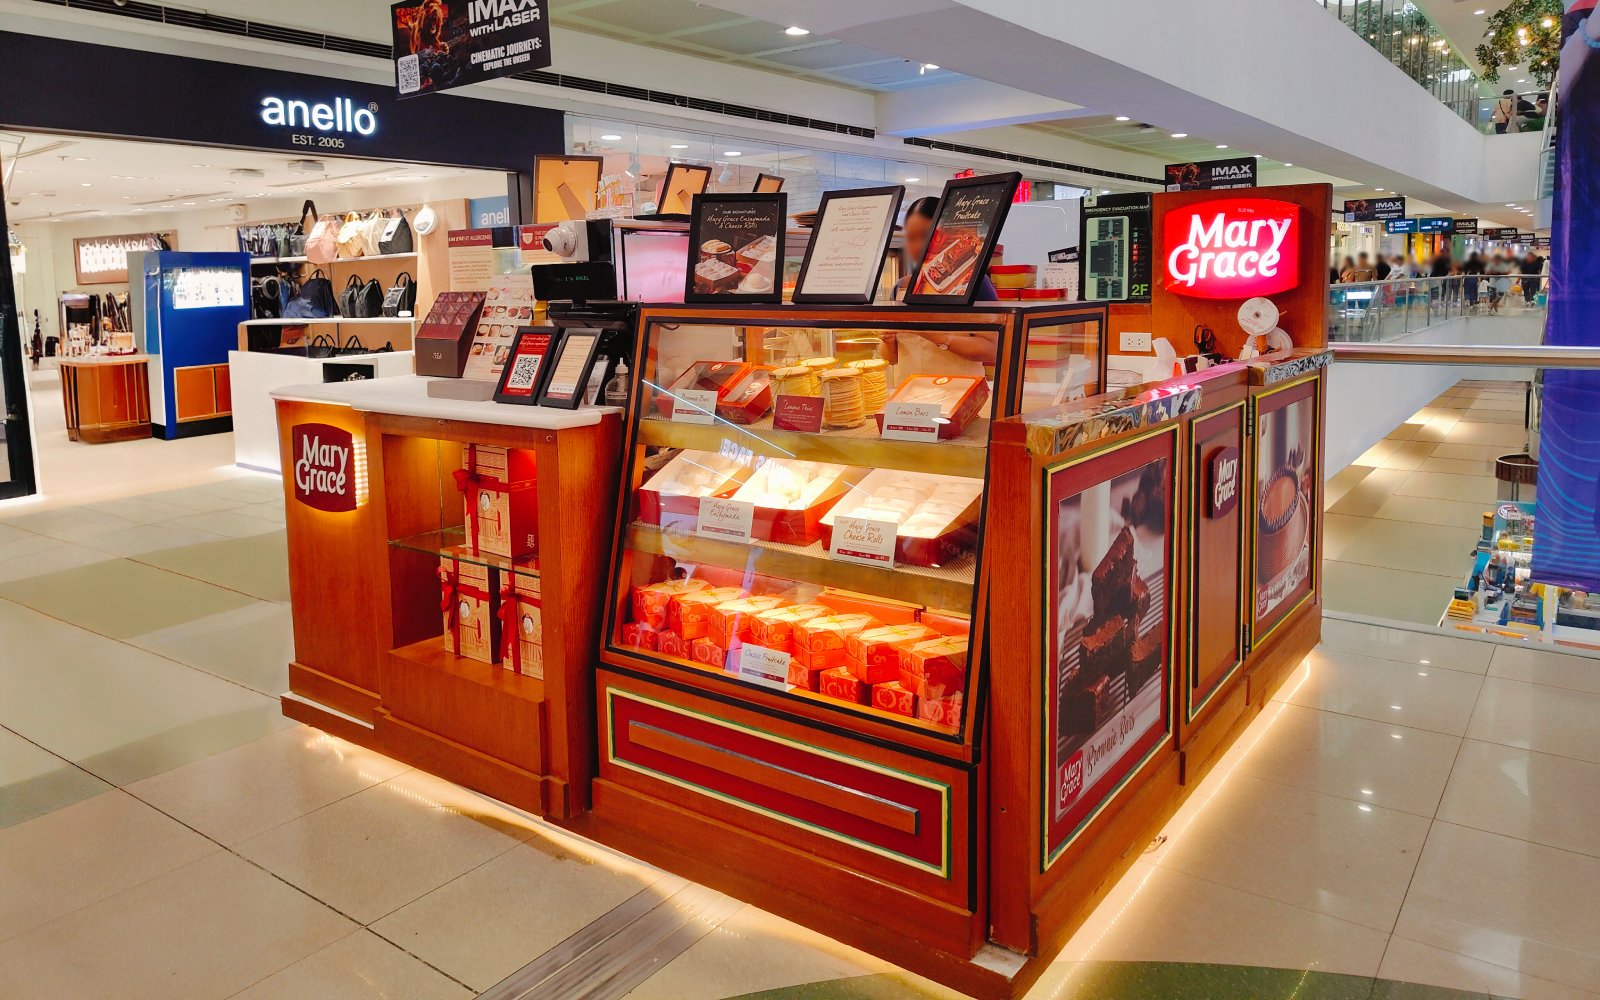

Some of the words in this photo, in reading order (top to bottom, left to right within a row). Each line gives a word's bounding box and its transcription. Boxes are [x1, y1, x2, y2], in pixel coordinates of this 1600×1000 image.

[470, 24, 493, 37] WITH
[494, 8, 540, 31] LASER
[471, 46, 505, 64] CINEMATIC
[507, 37, 542, 55] JOURNEYS:
[483, 58, 503, 71] EXPLORE
[504, 56, 512, 65] THE
[513, 53, 530, 64] UNSEEN
[292, 135, 315, 145] EST.
[318, 137, 344, 148] 2005
[1212, 165, 1250, 176] IMAX
[482, 207, 509, 225] anell
[1188, 213, 1292, 250] Mary
[1169, 243, 1280, 286] Grace
[1132, 284, 1148, 295] 2F
[896, 406, 913, 415] Lemon
[914, 408, 929, 416] Bars
[303, 434, 348, 473] Mary
[296, 459, 346, 495] Grace
[1218, 458, 1238, 484] Mary
[712, 501, 725, 511] Mary
[726, 503, 740, 512] Grace
[1214, 481, 1235, 510] Grace
[844, 530, 865, 541] Cheese
[866, 533, 883, 544] Rolls
[849, 520, 864, 534] Mary
[865, 523, 880, 533] Grace
[745, 649, 761, 659] Classic
[762, 653, 786, 665] Fruitcake
[1086, 728, 1117, 776] Brownie
[1120, 712, 1135, 745] Bars
[1065, 757, 1082, 781] Mary
[1061, 773, 1080, 803] Grace
